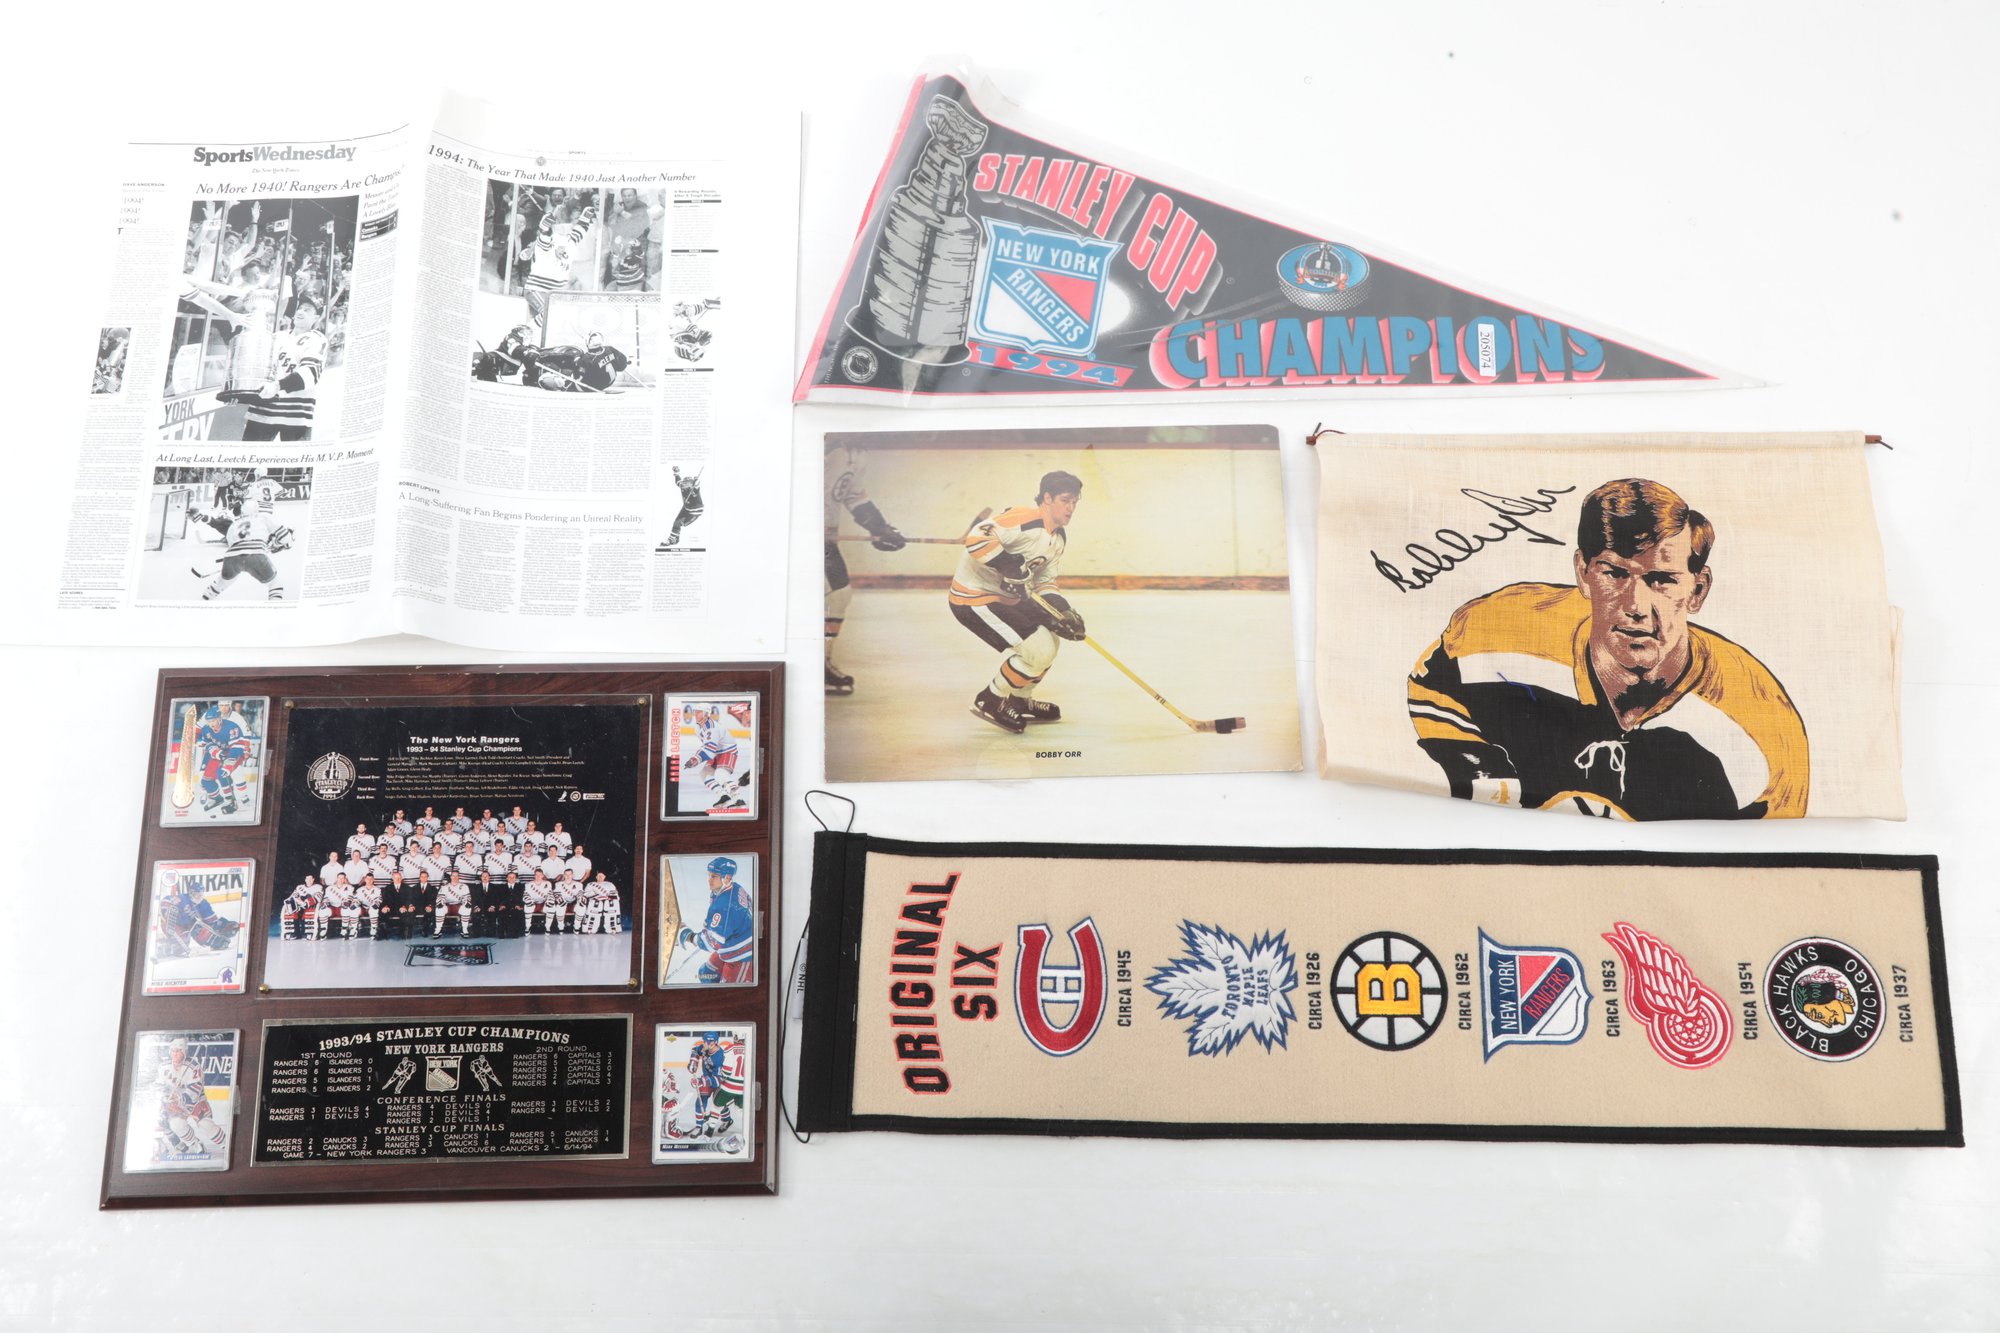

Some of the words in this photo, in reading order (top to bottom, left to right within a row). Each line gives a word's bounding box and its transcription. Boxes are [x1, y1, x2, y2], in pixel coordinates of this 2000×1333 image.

[192, 144, 356, 167] SportsWednesday
[428, 144, 464, 164] 1994:
[467, 158, 484, 172] The
[487, 164, 510, 177] Year
[514, 169, 536, 180] That
[538, 173, 566, 182] Made
[569, 174, 594, 182] 1940
[595, 174, 616, 183] Just
[619, 173, 656, 182] Another
[659, 172, 696, 182] Number
[196, 183, 213, 194] No
[217, 183, 247, 194] More
[251, 181, 287, 193] 1940!
[290, 180, 338, 193] Rangers
[340, 179, 362, 190] Are
[973, 152, 1136, 240] STANLEY
[1127, 192, 1217, 312] CUP
[997, 238, 1044, 263] NEW
[1050, 247, 1101, 275] YORK
[1006, 268, 1084, 342] RANGERS
[975, 345, 1119, 384] 1994
[1160, 315, 1605, 380] CHAMPIONS
[1480, 331, 1492, 368] 205074
[156, 453, 168, 462] At
[169, 454, 192, 463] Long
[193, 454, 216, 464] Last,
[217, 454, 246, 463] Leetch
[248, 454, 299, 464] Experiences
[300, 454, 314, 462] His
[316, 453, 344, 462] M.V.P.
[346, 448, 373, 459] Moment
[399, 492, 406, 500] A
[408, 492, 471, 515] Long-Suffering
[473, 507, 490, 517] Fan
[492, 509, 522, 520] Begins
[525, 512, 568, 524] Pondering
[583, 514, 611, 522] Unreal
[613, 514, 643, 524] Reality
[671, 709, 680, 752] LEETCH
[711, 913, 721, 928] 9
[888, 871, 962, 1096] ORIGINAL
[950, 941, 1004, 1022] SIX
[1117, 949, 1132, 986] 1945
[1242, 966, 1254, 1007] MAPLE
[1306, 952, 1321, 985] 1926
[1457, 952, 1470, 988] 1962
[1497, 960, 1515, 993] YORK
[1602, 960, 1616, 994] 1963
[1740, 962, 1752, 997] 1954
[1773, 946, 1818, 996] HAWKS
[1892, 964, 1908, 999] 1937
[1221, 955, 1241, 1020] TORONTO
[1256, 969, 1268, 1005] LEAFS
[1356, 960, 1420, 1017] B
[1523, 967, 1571, 1020] RANGERS
[1845, 959, 1877, 1039] CHICAGO
[1118, 989, 1132, 1027] CIRCA
[1308, 991, 1322, 1030] CIRCA
[1459, 991, 1471, 1031] CIRCA
[1500, 1000, 1518, 1030] NEW
[1606, 998, 1620, 1038] CIRCA
[1744, 1001, 1757, 1040] CIRCA
[1900, 1002, 1916, 1043] CIRCA
[319, 1033, 372, 1051] 1993/94
[377, 1026, 444, 1041] STANLEY
[448, 1026, 476, 1036] CUP
[480, 1027, 570, 1044] CHAMPIONS
[1776, 1004, 1828, 1052] BLACK
[385, 1045, 411, 1055] NEW
[415, 1044, 446, 1054] YORK
[450, 1043, 504, 1053] RANGERS
[377, 1095, 456, 1104] CONFERENCE
[375, 1126, 427, 1134] STANLEY
[434, 1125, 456, 1133] CUP
